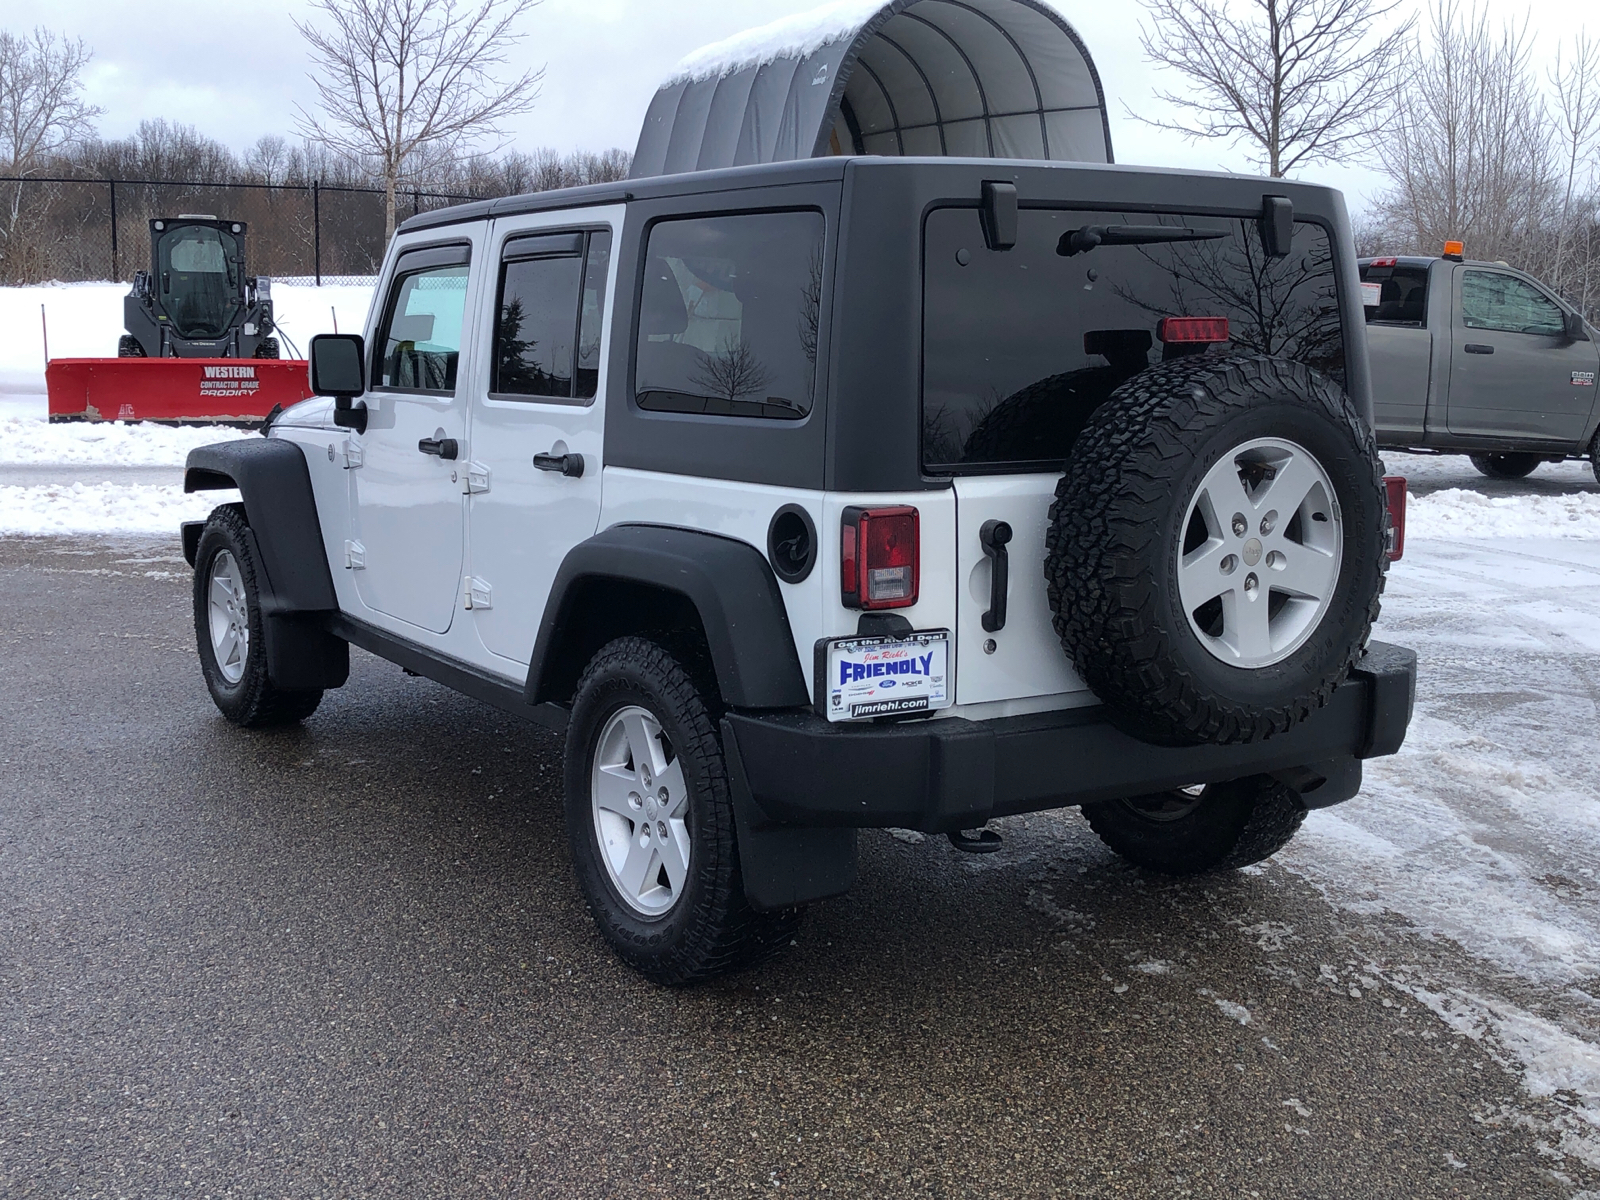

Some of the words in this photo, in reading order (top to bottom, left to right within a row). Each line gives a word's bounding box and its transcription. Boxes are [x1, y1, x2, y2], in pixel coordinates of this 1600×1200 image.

[204, 366, 255, 378] WESTERN
[838, 641, 858, 649] Get
[864, 653, 879, 664] Jim
[882, 650, 908, 660] Riehl's
[840, 650, 934, 686] FRIENDLY
[854, 698, 926, 716] jimriehl.com
